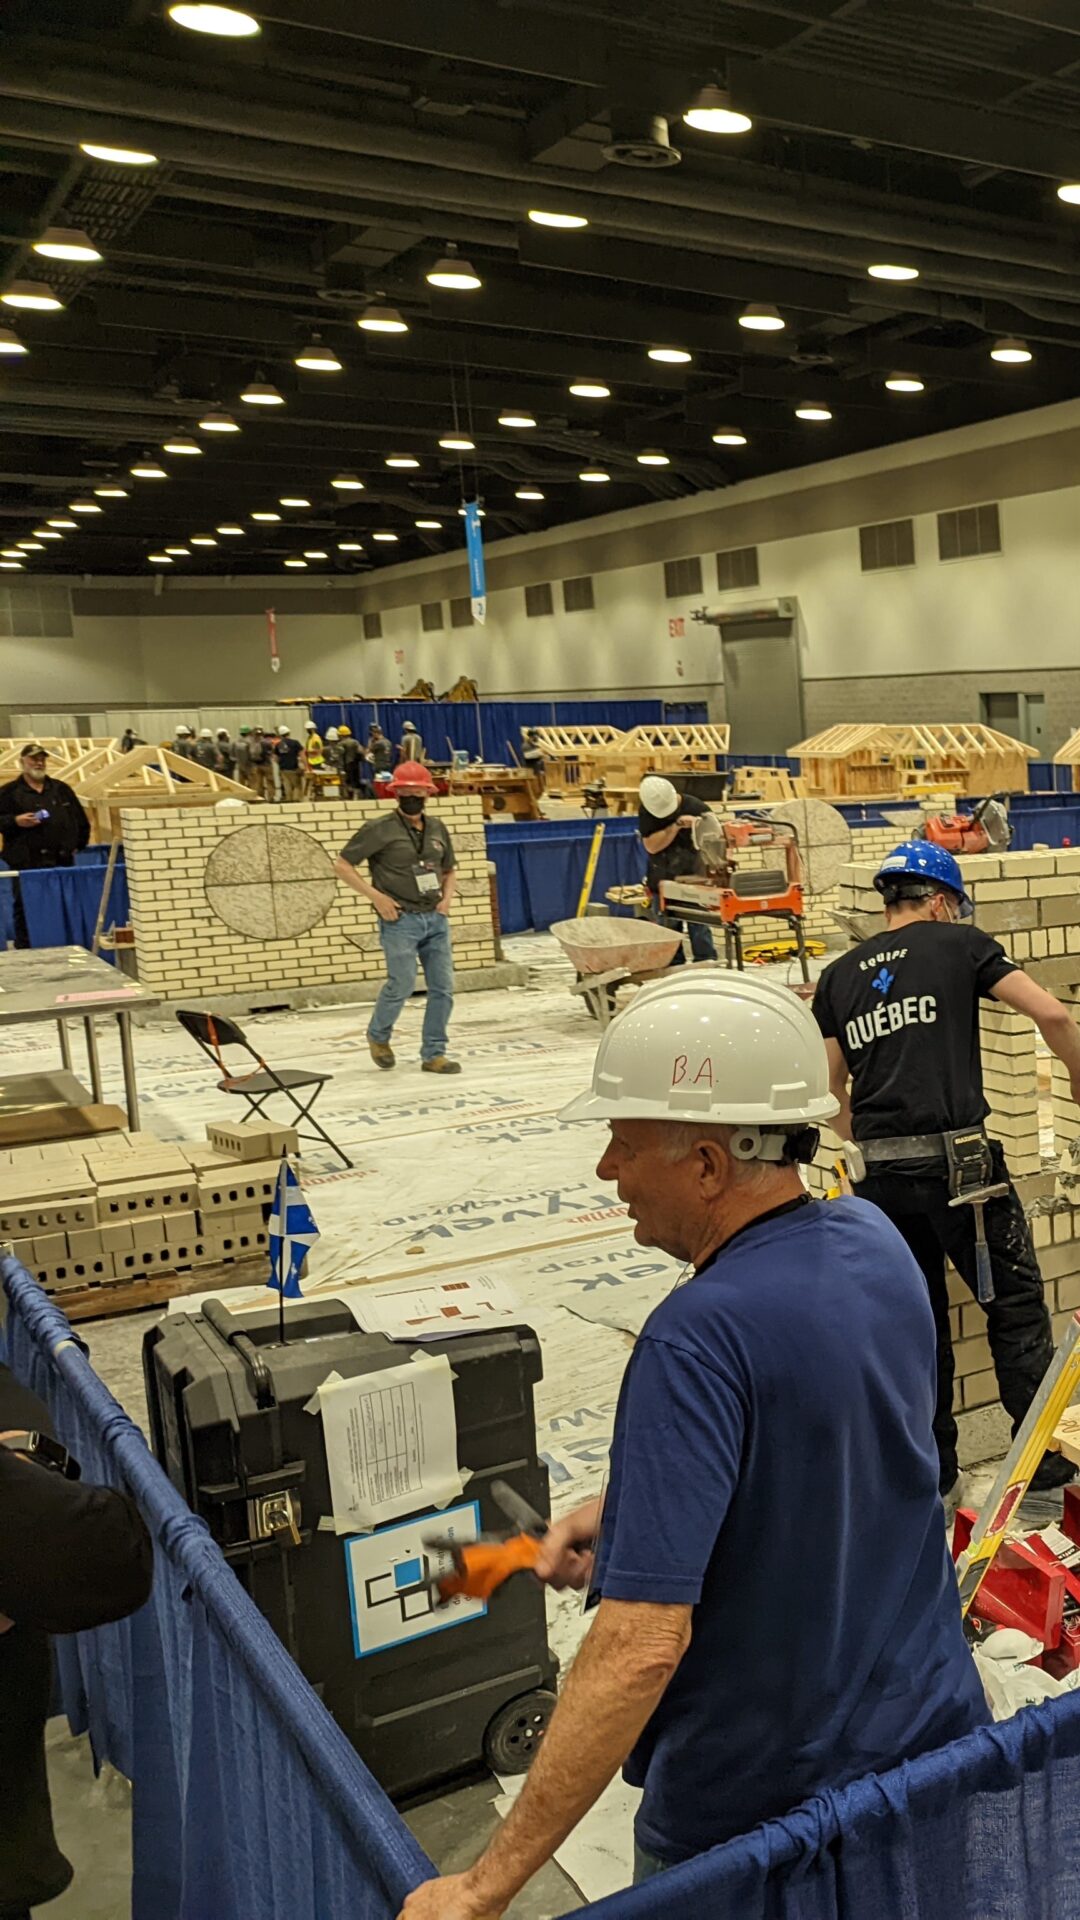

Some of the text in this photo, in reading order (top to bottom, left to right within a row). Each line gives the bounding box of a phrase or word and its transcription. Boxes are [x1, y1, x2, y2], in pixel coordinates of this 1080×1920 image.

[859, 948, 908, 971] ÉQUIPE
[845, 995, 937, 1050] QUÉBEC
[402, 1194, 621, 1243] Tyvek
